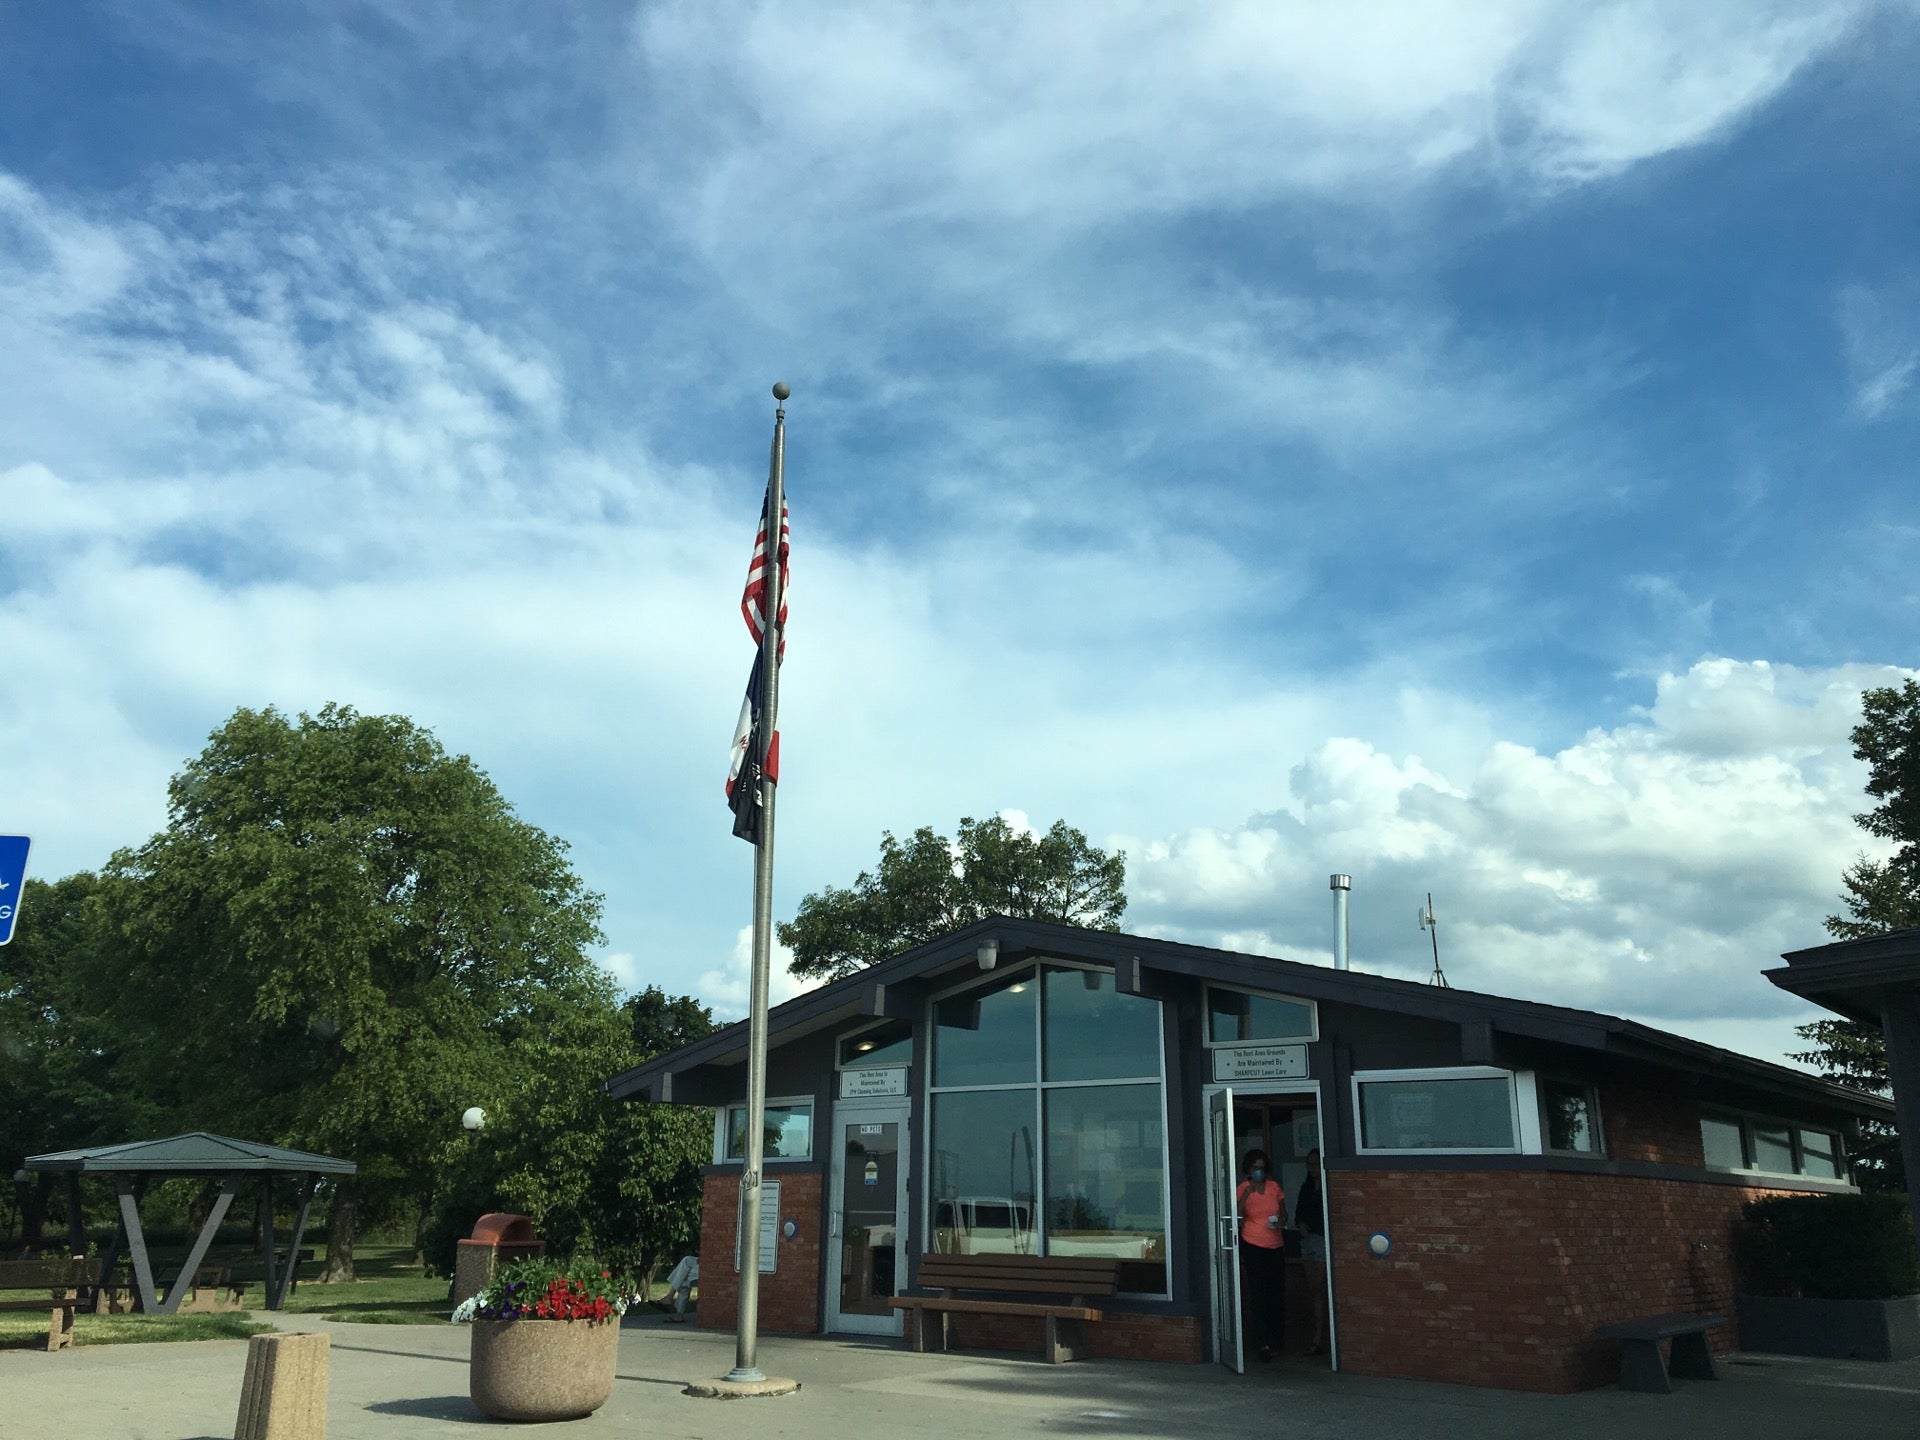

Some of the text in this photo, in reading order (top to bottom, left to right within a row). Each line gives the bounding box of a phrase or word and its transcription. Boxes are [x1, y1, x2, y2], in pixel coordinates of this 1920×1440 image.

[1266, 1048, 1286, 1056] Grounds
[1247, 1059, 1274, 1067] Maintained
[1276, 1058, 1283, 1066] By
[1262, 1068, 1275, 1076] Lawn
